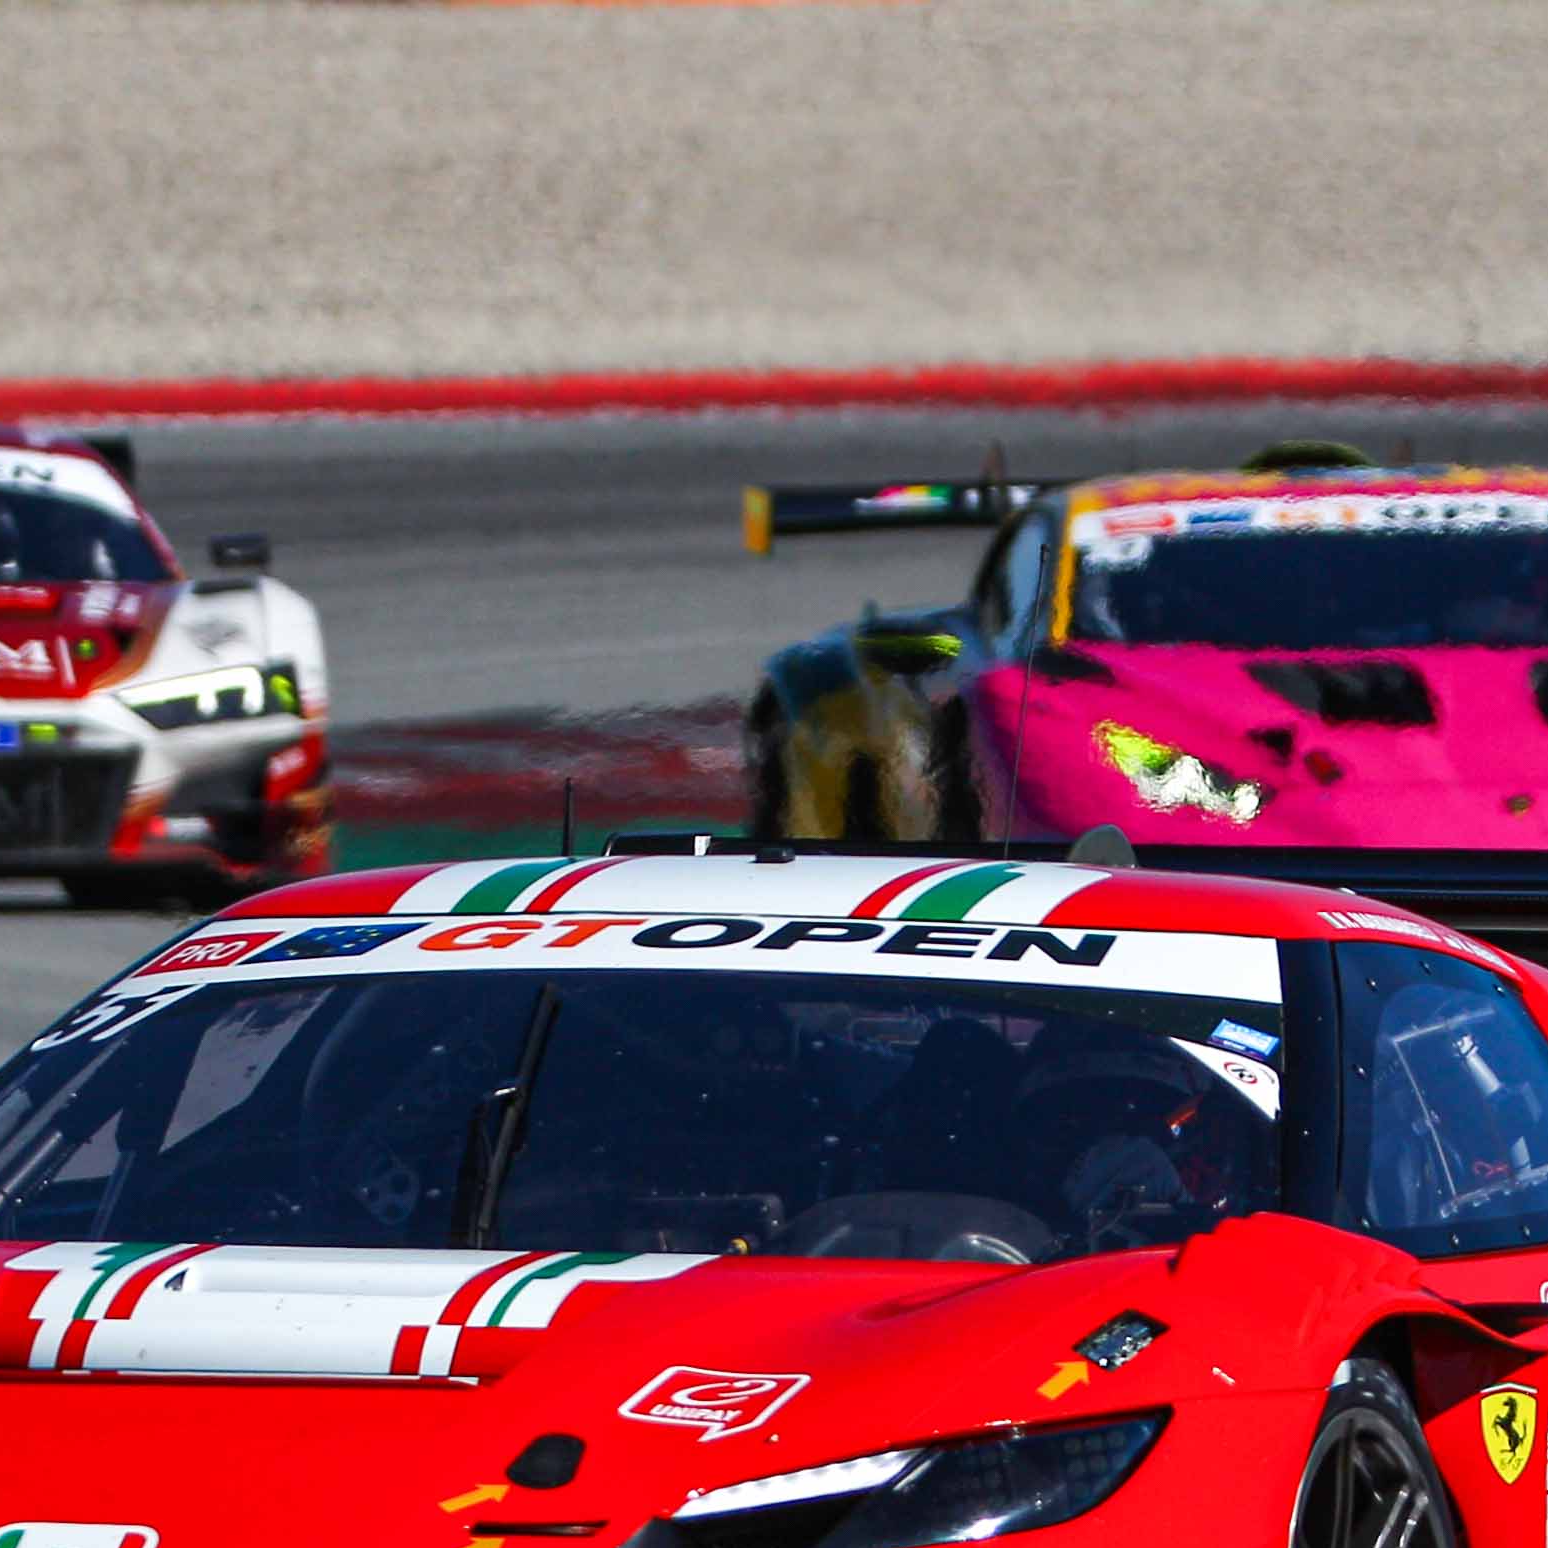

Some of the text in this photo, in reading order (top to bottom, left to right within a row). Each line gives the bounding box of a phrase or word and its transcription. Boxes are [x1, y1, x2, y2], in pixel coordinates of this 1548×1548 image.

[161, 939, 243, 967] PRO
[30, 984, 208, 1051] 51
[649, 1403, 743, 1422] UNIPAY
